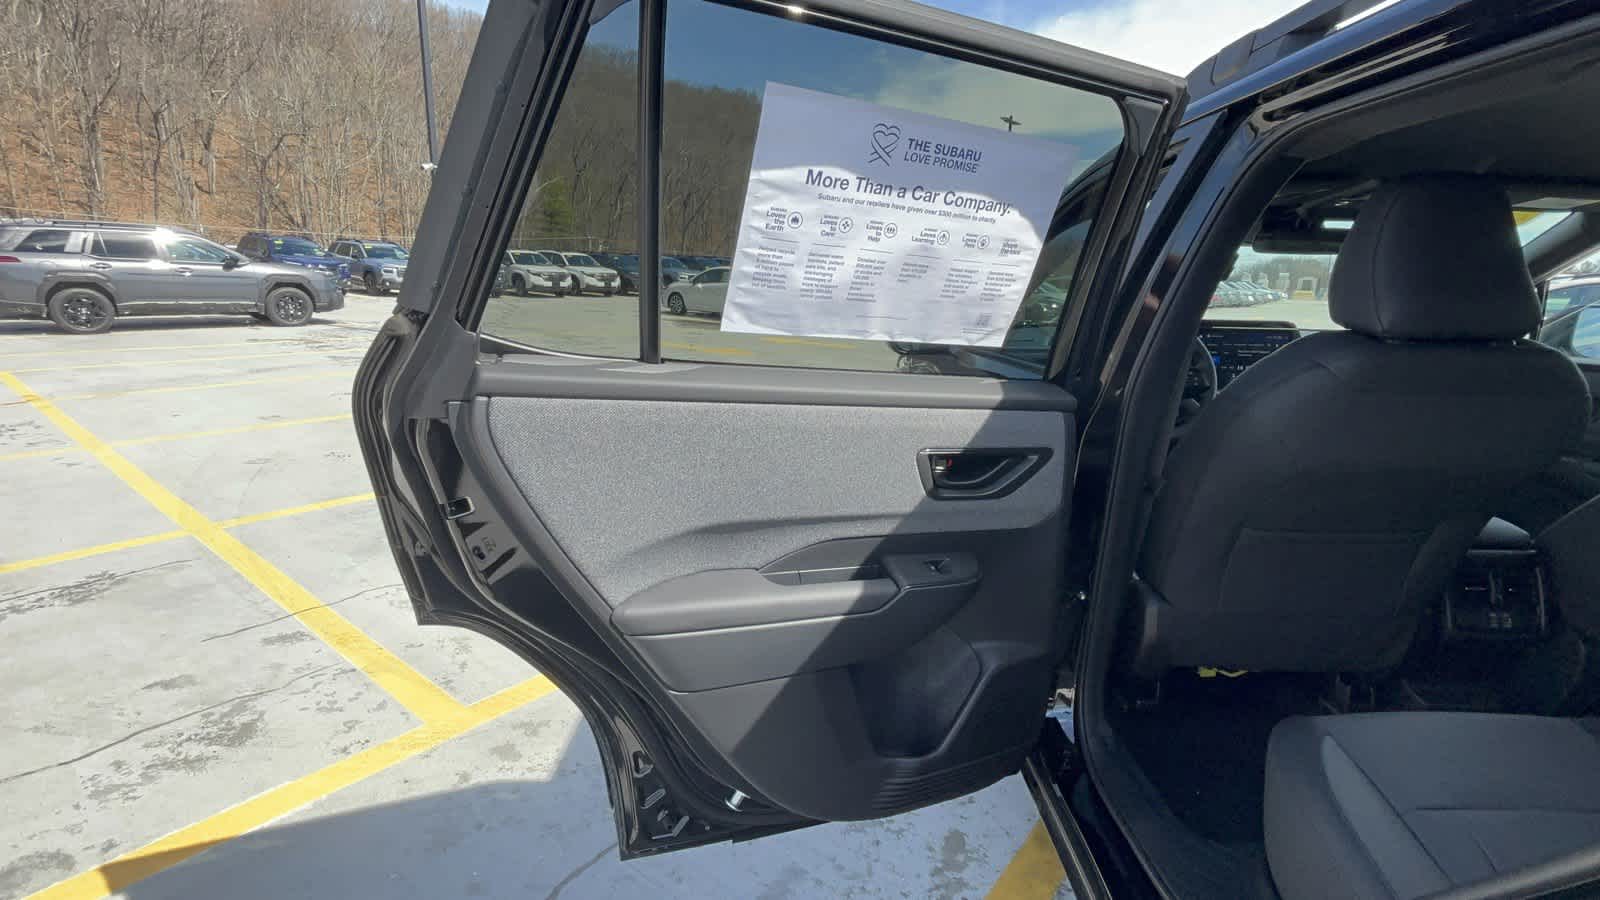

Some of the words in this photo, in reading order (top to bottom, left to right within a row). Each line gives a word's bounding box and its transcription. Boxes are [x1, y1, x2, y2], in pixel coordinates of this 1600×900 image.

[907, 138, 932, 153] THE
[934, 143, 982, 162] SUBARU
[904, 151, 931, 166] LOVE
[932, 156, 979, 174] PROMISE
[805, 168, 850, 191] More
[855, 176, 893, 198] Than
[896, 186, 907, 199] a
[911, 185, 941, 204] Car
[943, 190, 1011, 217] Company.
[817, 192, 841, 202] Subaru
[890, 202, 906, 210] have
[906, 205, 923, 214] given
[766, 210, 787, 218] Loves
[820, 218, 838, 226] Loves
[765, 223, 784, 232] Earth
[866, 223, 882, 231] Loves
[820, 229, 835, 237] Care
